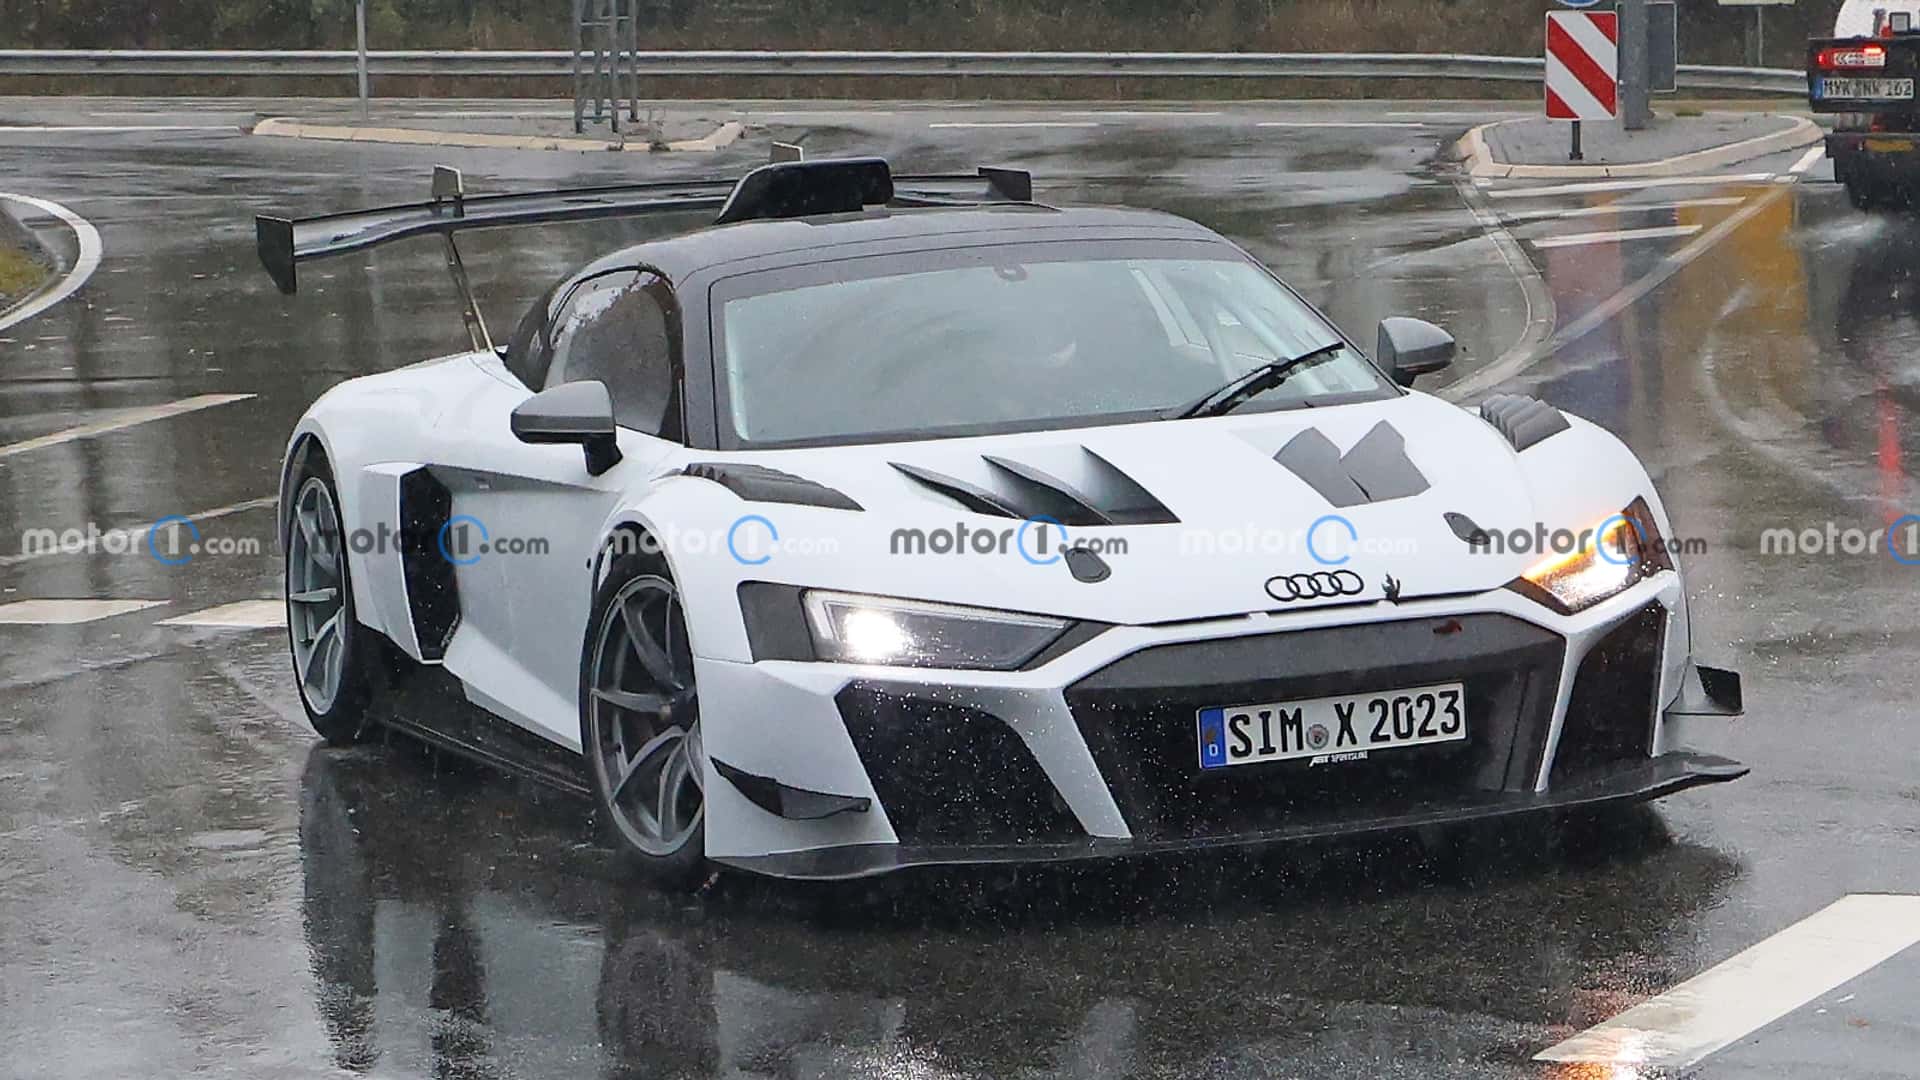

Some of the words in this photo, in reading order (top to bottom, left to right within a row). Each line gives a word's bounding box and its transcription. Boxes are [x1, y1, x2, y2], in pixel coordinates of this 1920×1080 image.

[1228, 707, 1304, 758] SIM
[1334, 701, 1358, 747] X
[1368, 689, 1461, 743] 2023
